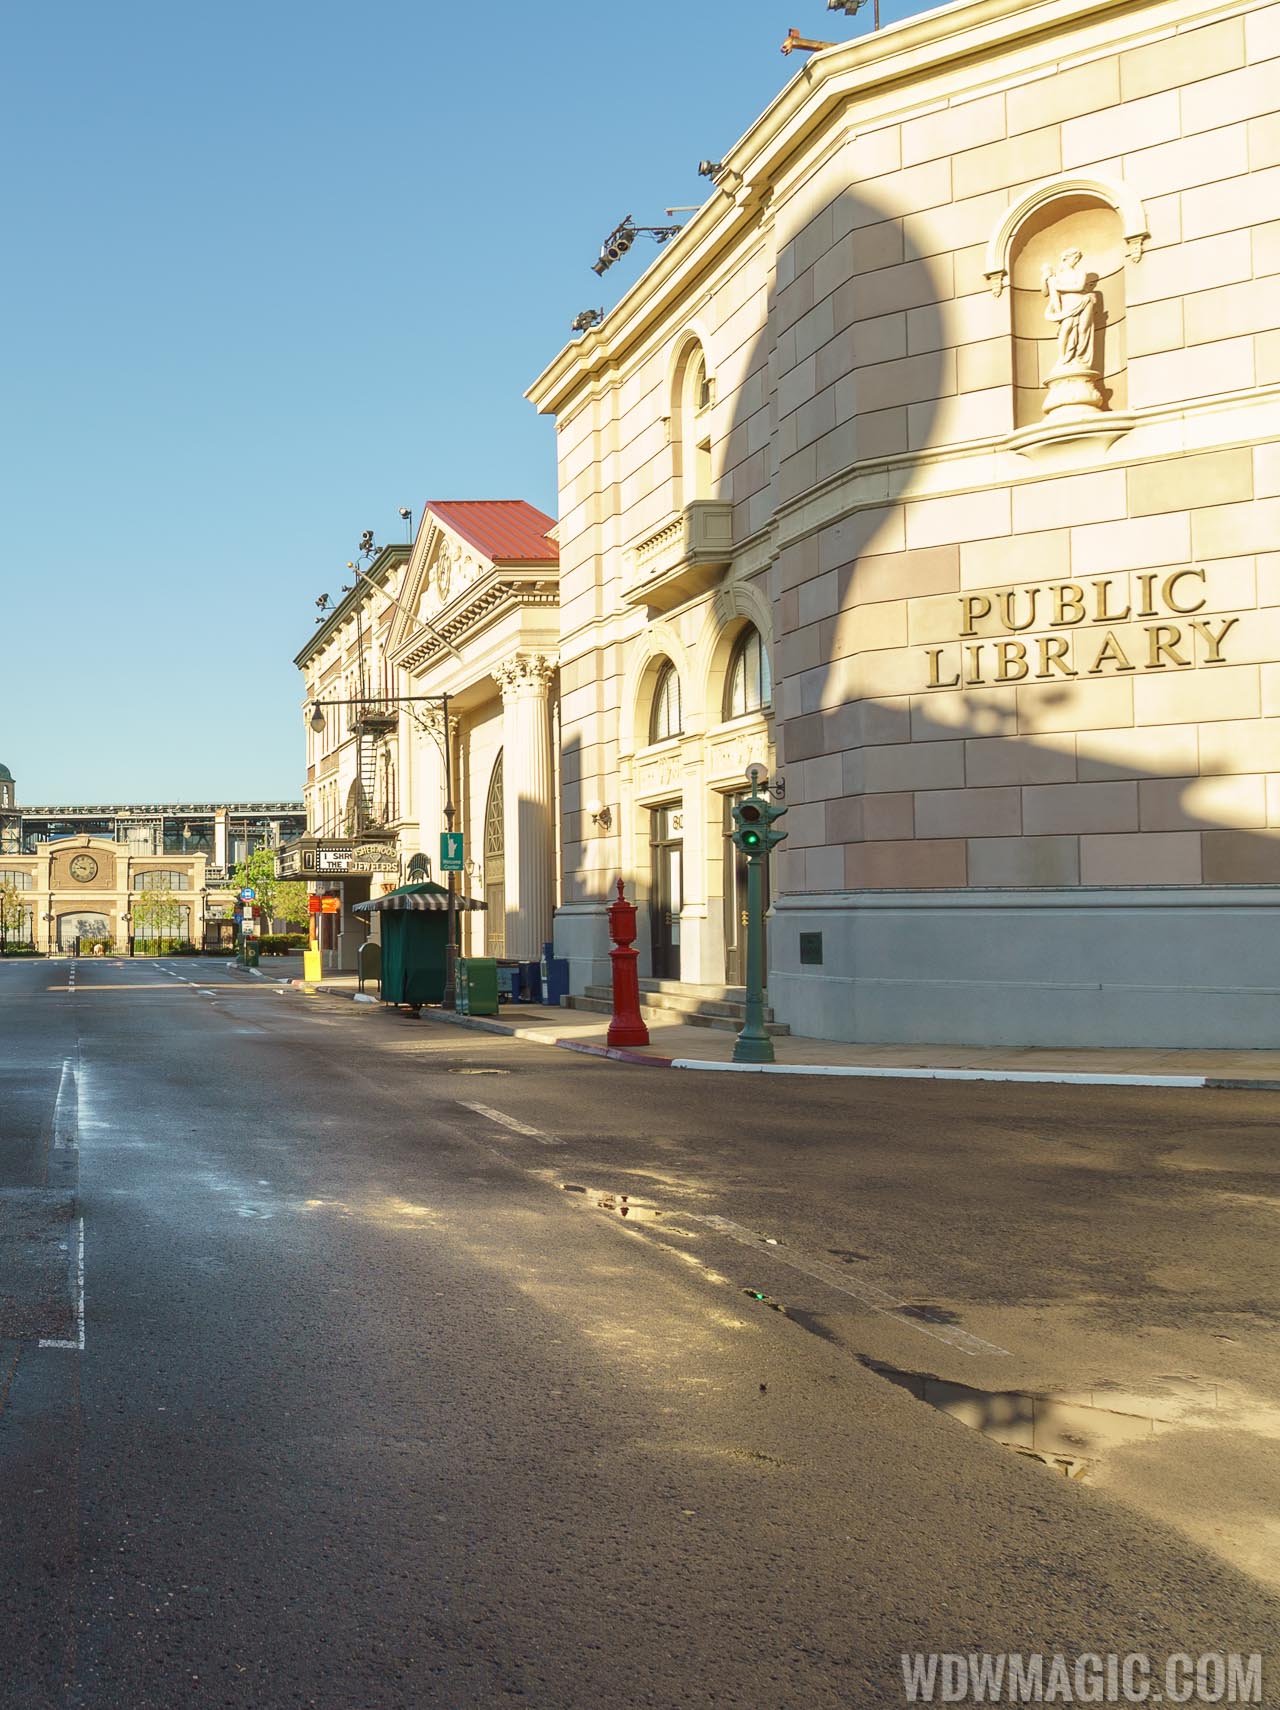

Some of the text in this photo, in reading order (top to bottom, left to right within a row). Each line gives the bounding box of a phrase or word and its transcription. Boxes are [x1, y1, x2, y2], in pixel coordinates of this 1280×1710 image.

[958, 568, 1207, 637] PUBLIC
[924, 618, 1239, 689] LIBRARY
[327, 861, 342, 869] THE
[352, 862, 398, 872] JEWELERS
